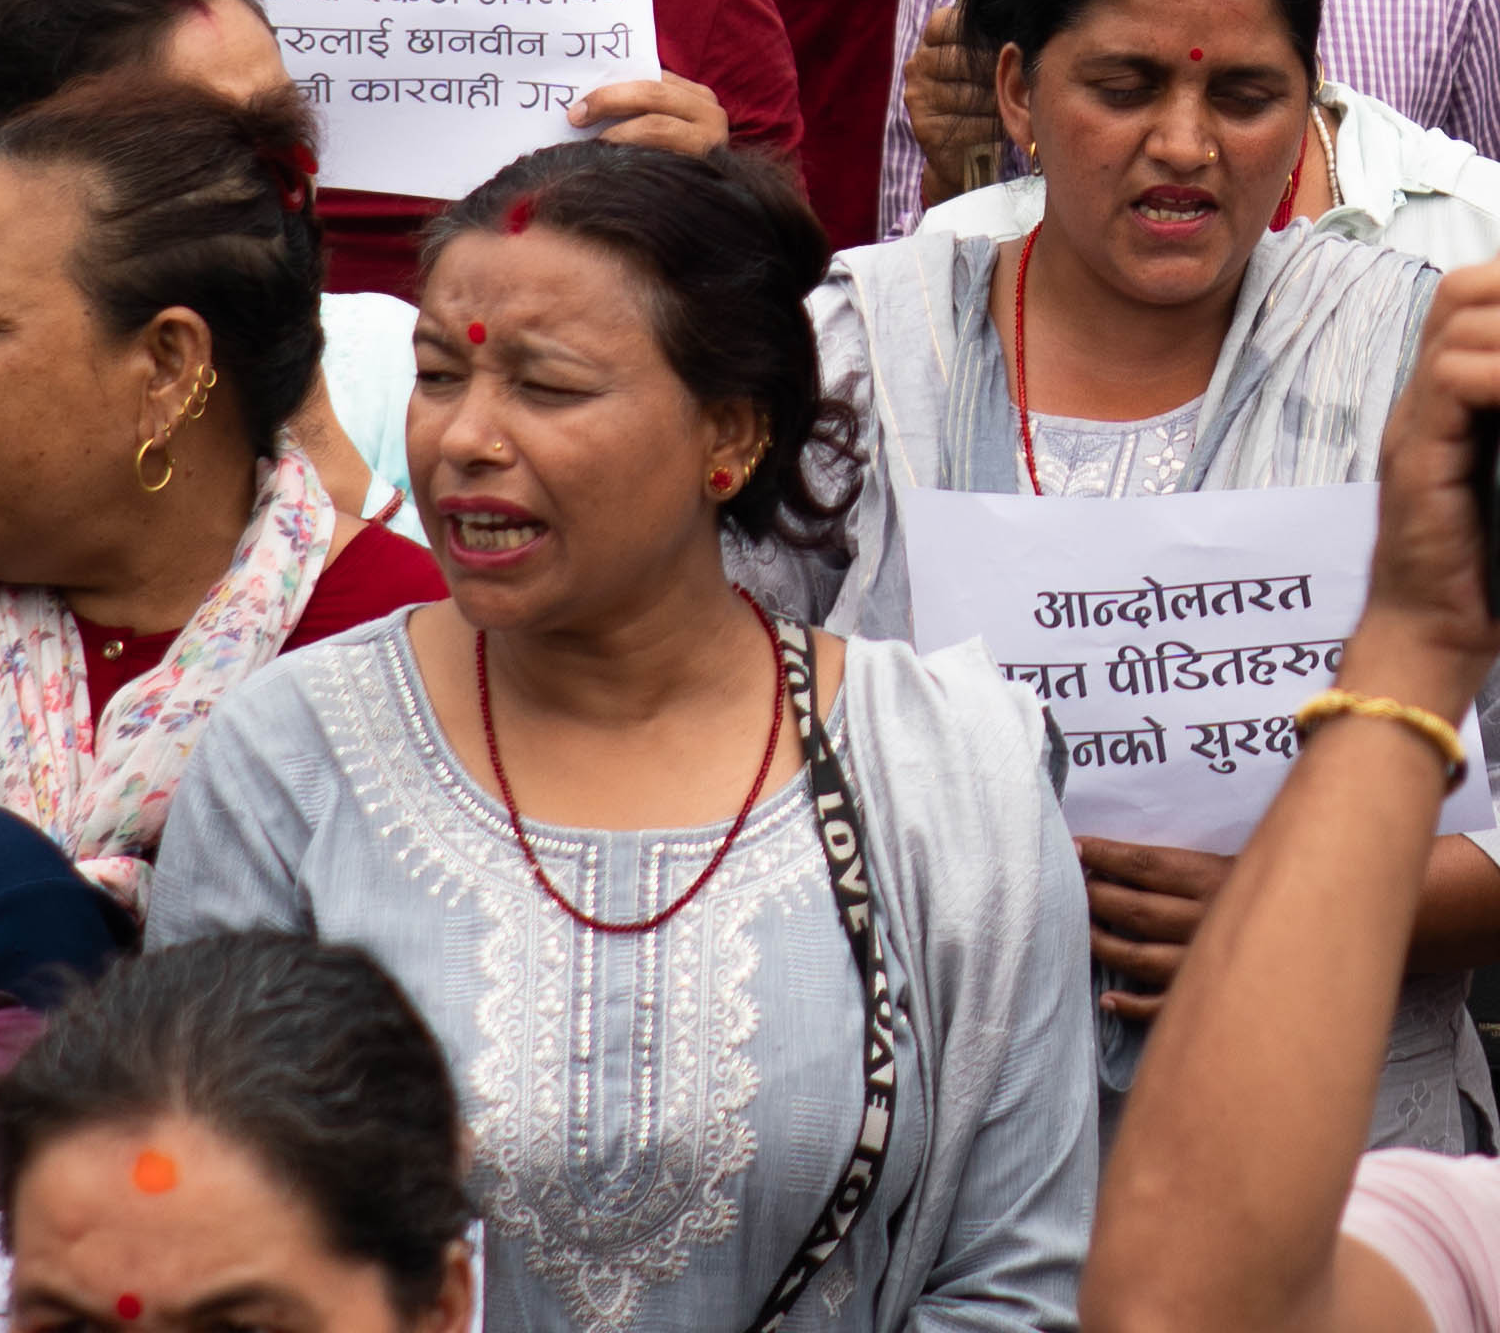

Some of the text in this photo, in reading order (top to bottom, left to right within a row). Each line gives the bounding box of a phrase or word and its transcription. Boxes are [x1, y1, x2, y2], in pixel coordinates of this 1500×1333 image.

[562, 23, 632, 59] गरी
[349, 73, 504, 109] कारवाही
[518, 79, 579, 112] गर
[1034, 575, 1311, 629] आन्दोलतरत
